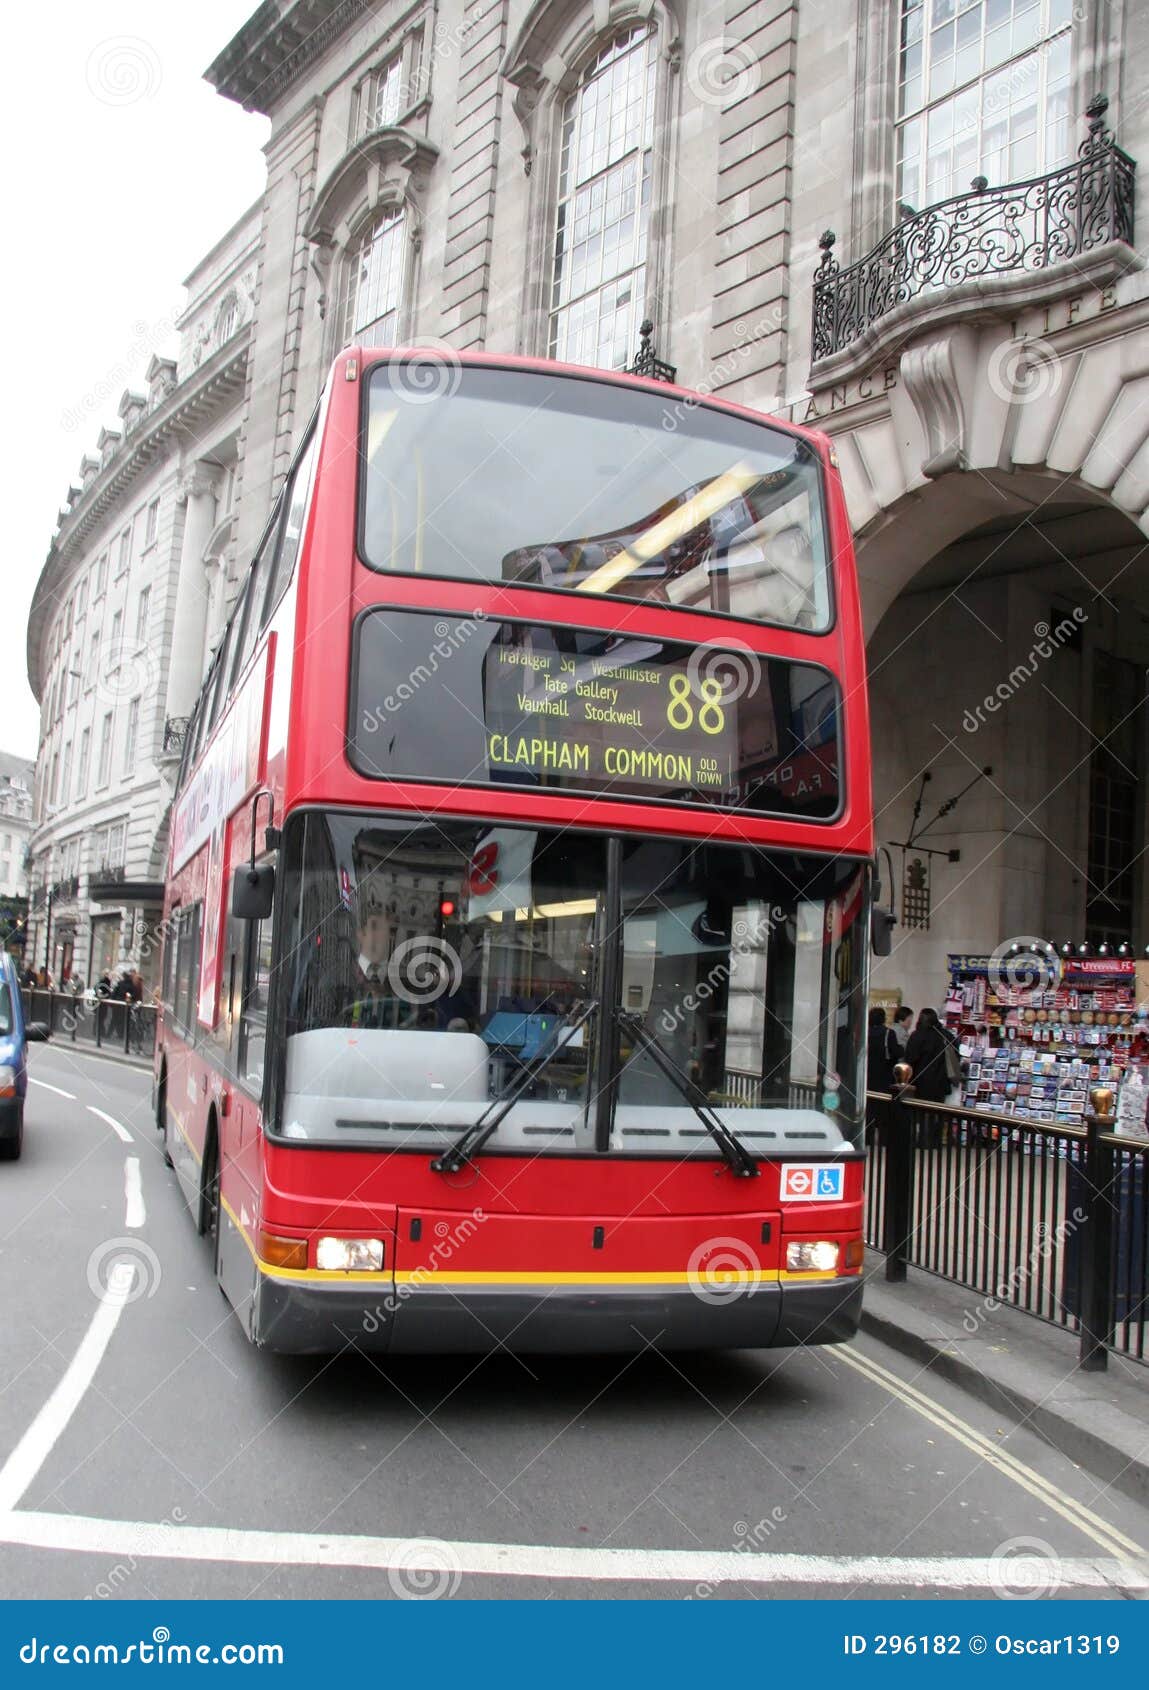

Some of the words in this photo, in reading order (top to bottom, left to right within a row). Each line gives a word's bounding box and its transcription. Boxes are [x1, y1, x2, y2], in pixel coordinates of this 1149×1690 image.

[499, 648, 552, 671] Trafalgar
[560, 656, 575, 678] Sq
[592, 660, 661, 685] Westminster
[544, 674, 568, 694] Tate
[575, 680, 618, 704] Gallery
[667, 673, 725, 735] 88
[517, 693, 569, 717] Vauxhall
[584, 703, 643, 727] Stockwell
[489, 734, 590, 771] CLAPHAM
[604, 747, 692, 783] COMMON
[700, 757, 717, 771] OLD
[696, 770, 722, 785] TOWN
